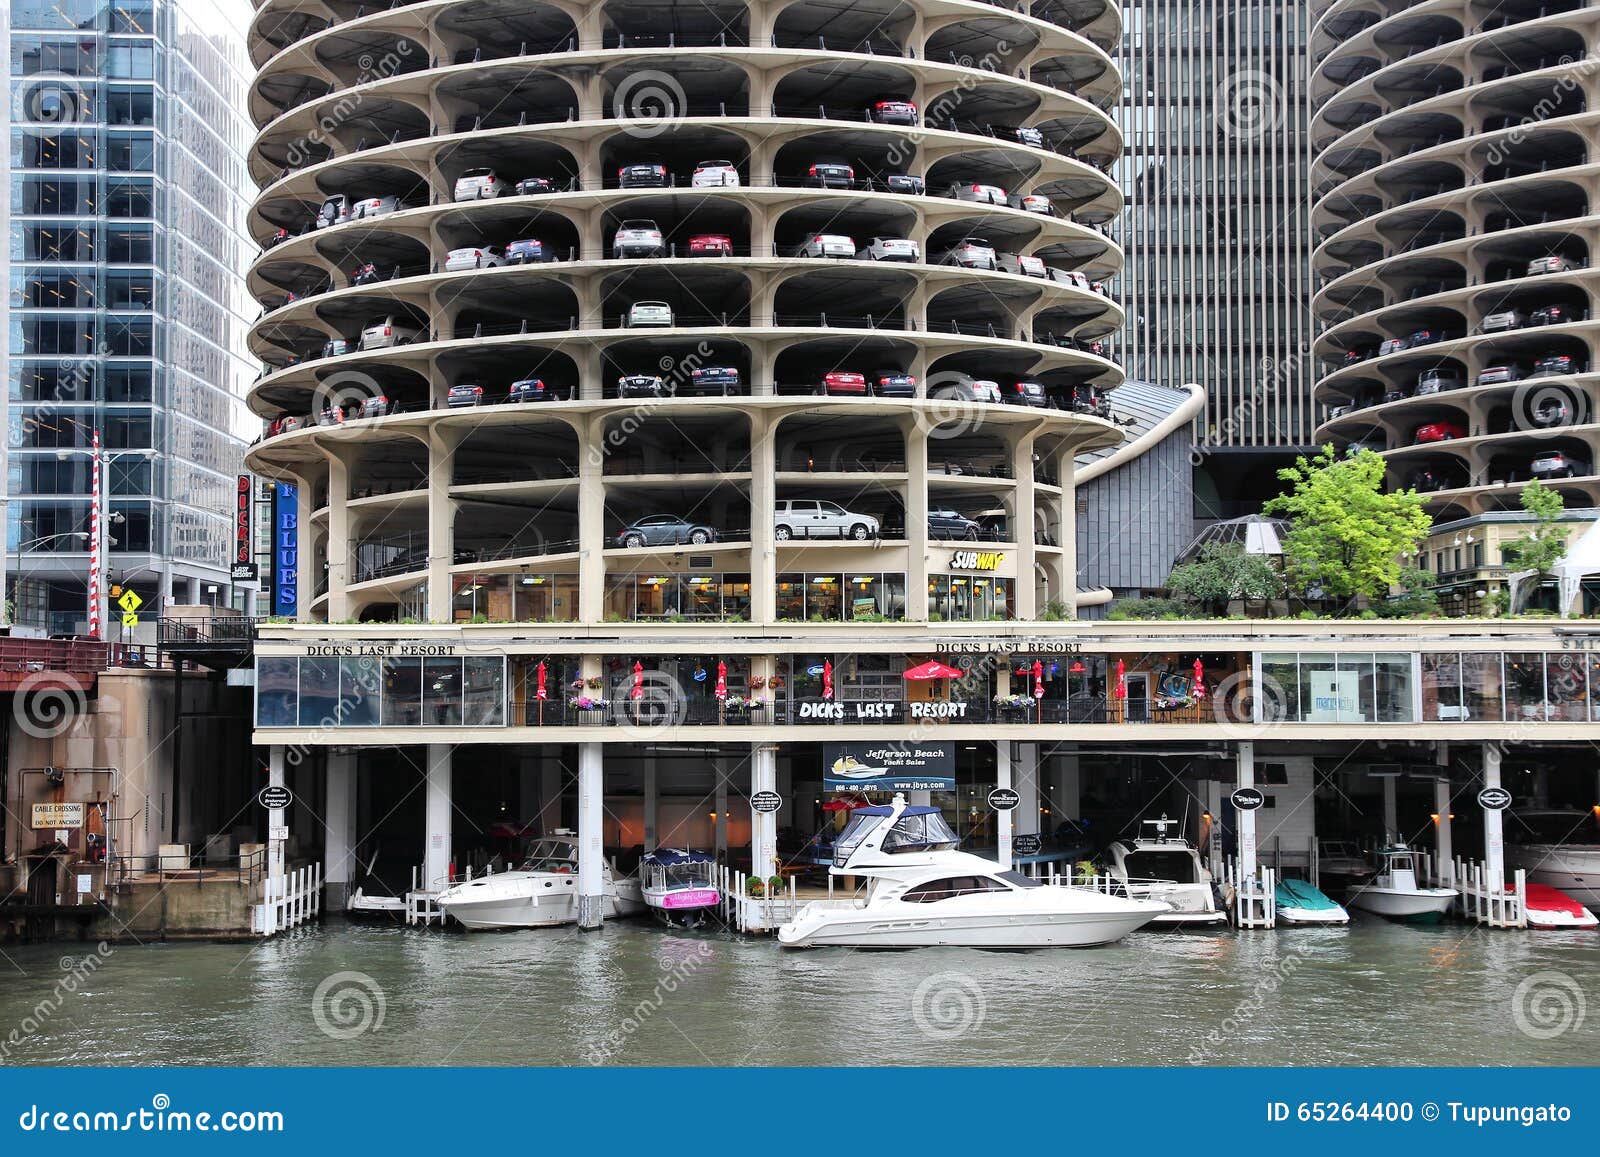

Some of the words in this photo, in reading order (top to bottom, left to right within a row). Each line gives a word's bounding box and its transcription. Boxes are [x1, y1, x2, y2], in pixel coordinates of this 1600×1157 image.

[237, 476, 250, 562] DICK'S
[280, 513, 298, 604] BLUES
[951, 551, 1006, 571] SUBWAY
[935, 642, 981, 653] DICK'S
[987, 642, 1021, 652] LAST
[1028, 642, 1082, 652] RESORT
[1562, 639, 1600, 650] SMI
[306, 645, 353, 656] DICK'S
[359, 645, 394, 656] LAST
[400, 645, 456, 656] RESORT
[800, 702, 845, 719] DICK'S
[856, 702, 895, 719] LAST
[910, 702, 968, 718] RESORT
[865, 750, 912, 760] Jefferson
[914, 749, 945, 758] Beach
[894, 781, 945, 790] www.jbys.com
[35, 805, 52, 813] CABLE
[54, 805, 81, 813] CROSSING
